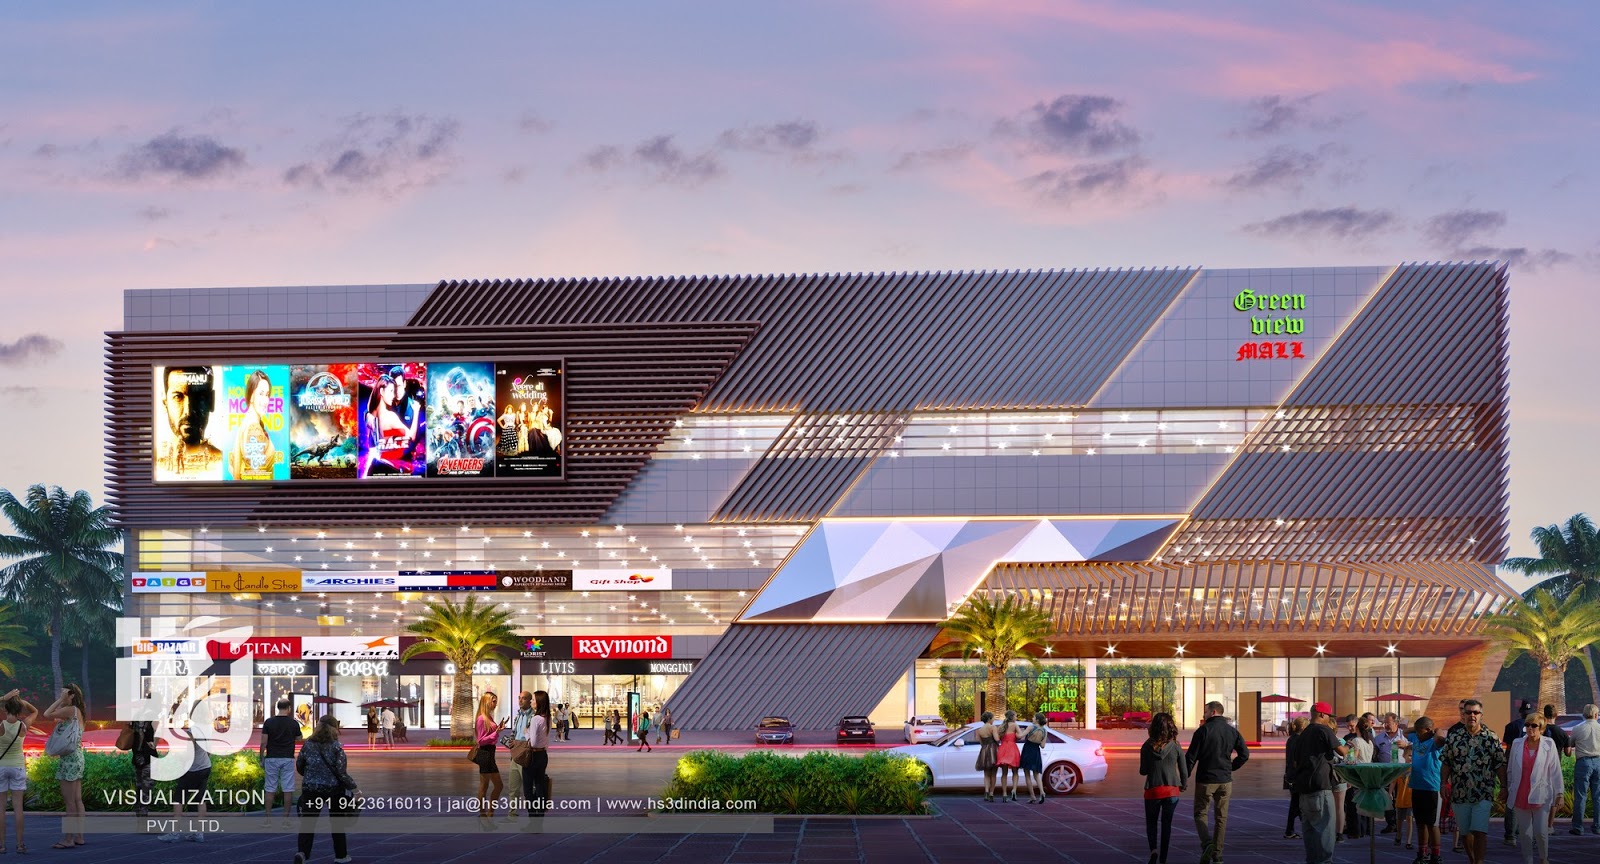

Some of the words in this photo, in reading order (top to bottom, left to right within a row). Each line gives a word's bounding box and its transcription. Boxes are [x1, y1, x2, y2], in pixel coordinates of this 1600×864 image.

[1234, 289, 1306, 311] Green
[1251, 314, 1304, 335] view
[1236, 341, 1306, 361] MALL
[229, 398, 284, 413] MOER
[378, 436, 412, 450] RACE
[437, 456, 484, 474] AVENGERS
[132, 578, 206, 587] PAIGE
[211, 579, 231, 590] The
[233, 573, 269, 591] Candle
[272, 578, 298, 590] Shop
[136, 643, 155, 653] BIG
[157, 643, 197, 653] BAZAAR
[244, 642, 292, 655] TITAN
[578, 637, 668, 658] Raymond
[153, 661, 193, 676] ZARA
[258, 664, 306, 677] mango
[336, 661, 390, 677] BIBA
[445, 662, 499, 674] adas
[540, 662, 575, 674] LIVIS
[651, 664, 694, 673] MONGGINI
